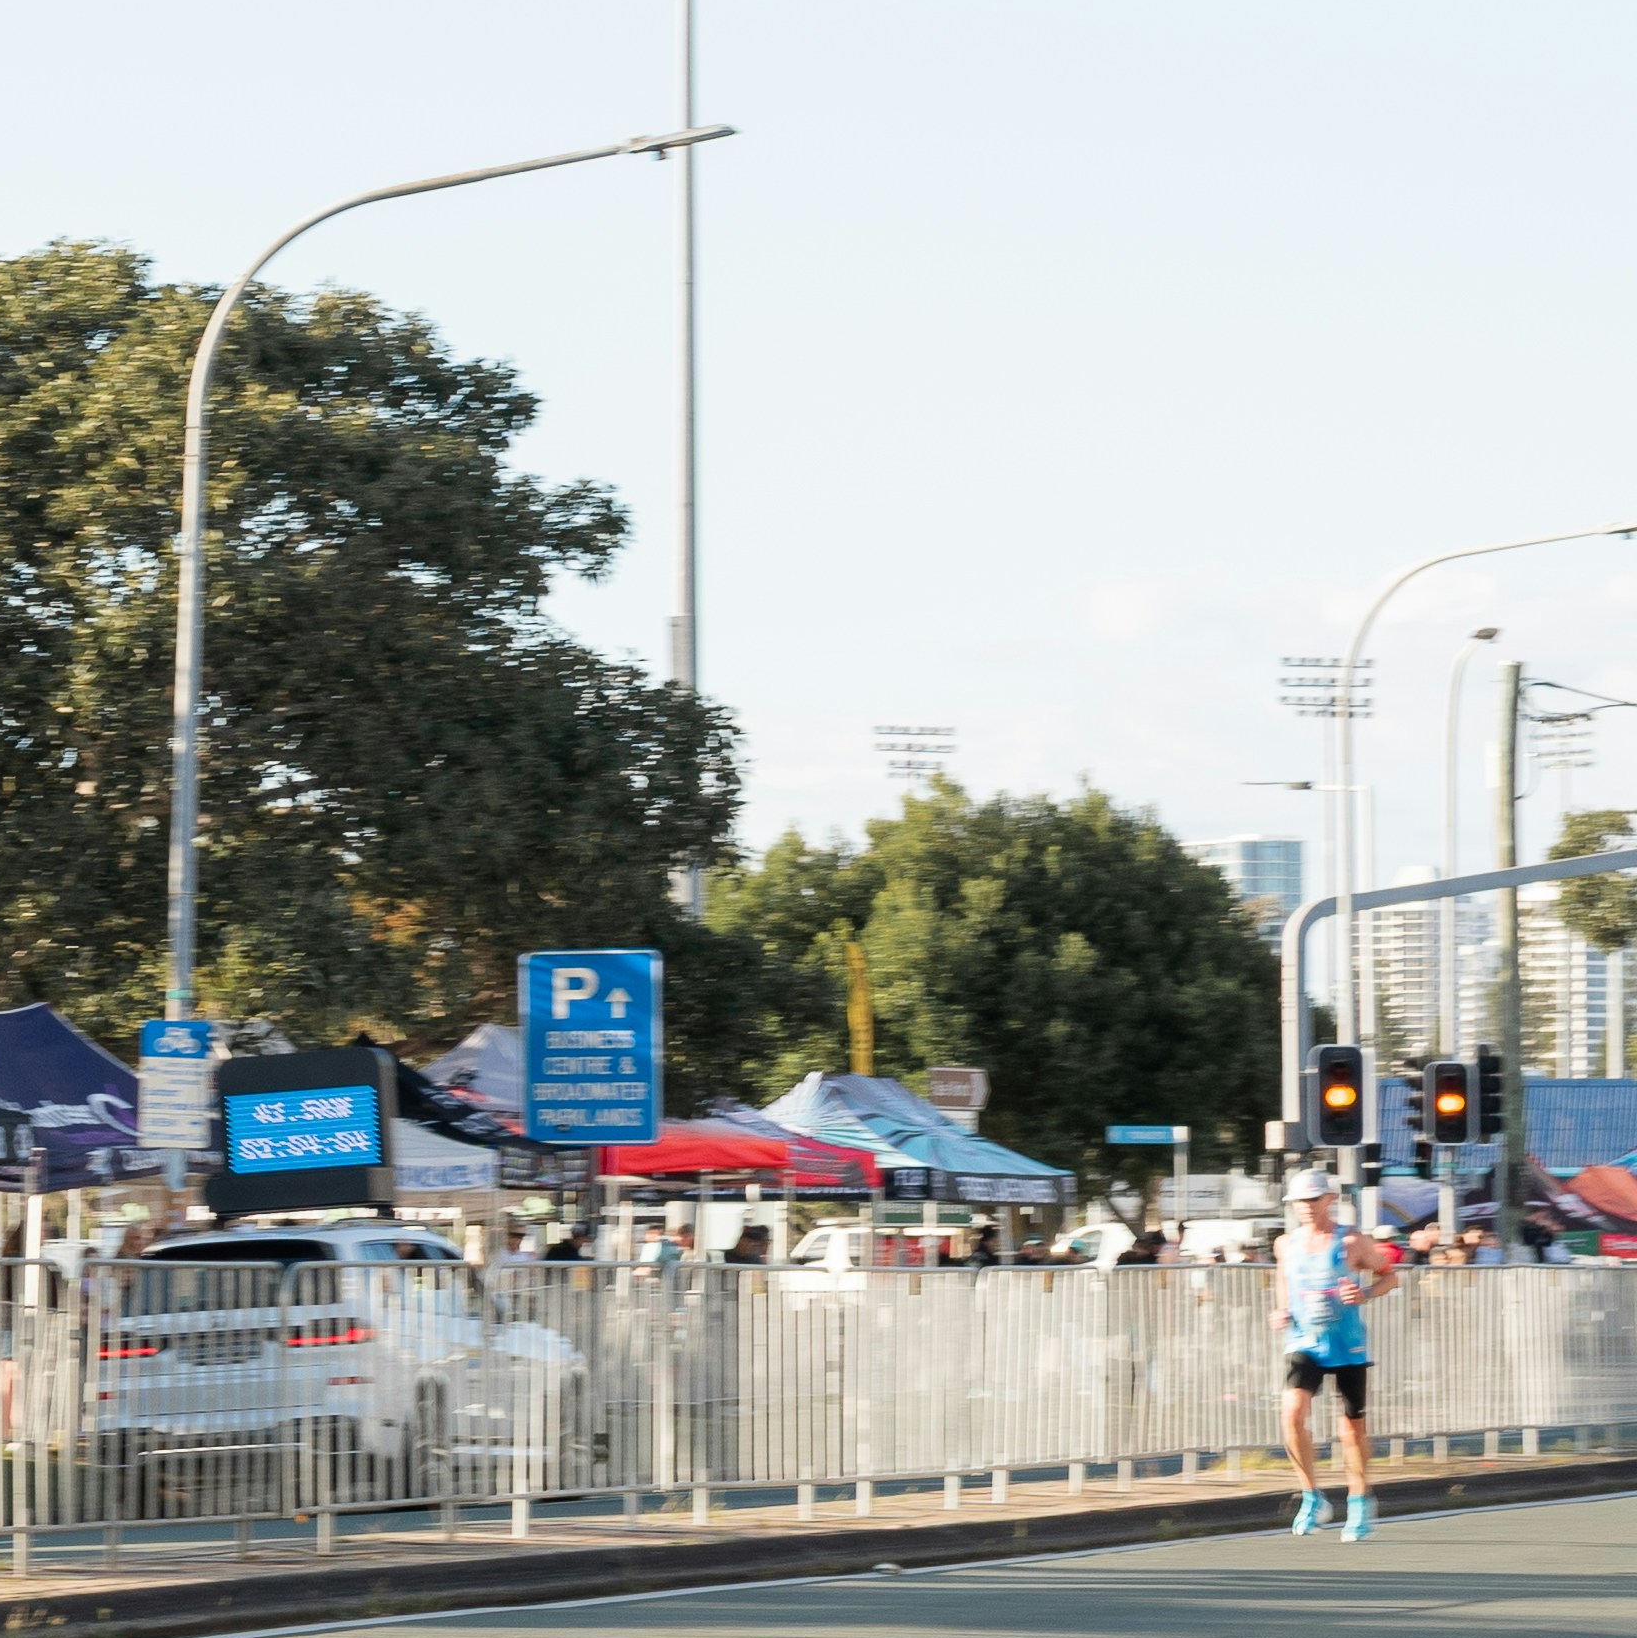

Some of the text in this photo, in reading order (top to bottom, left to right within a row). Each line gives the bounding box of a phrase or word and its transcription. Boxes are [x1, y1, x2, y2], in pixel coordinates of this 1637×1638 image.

[551, 967, 600, 1020] P
[545, 1030, 636, 1049] BUSINESS
[542, 1056, 614, 1075] CENTRE
[532, 1082, 648, 1101] BROADWATER
[536, 1108, 644, 1127] PARKLANDS
